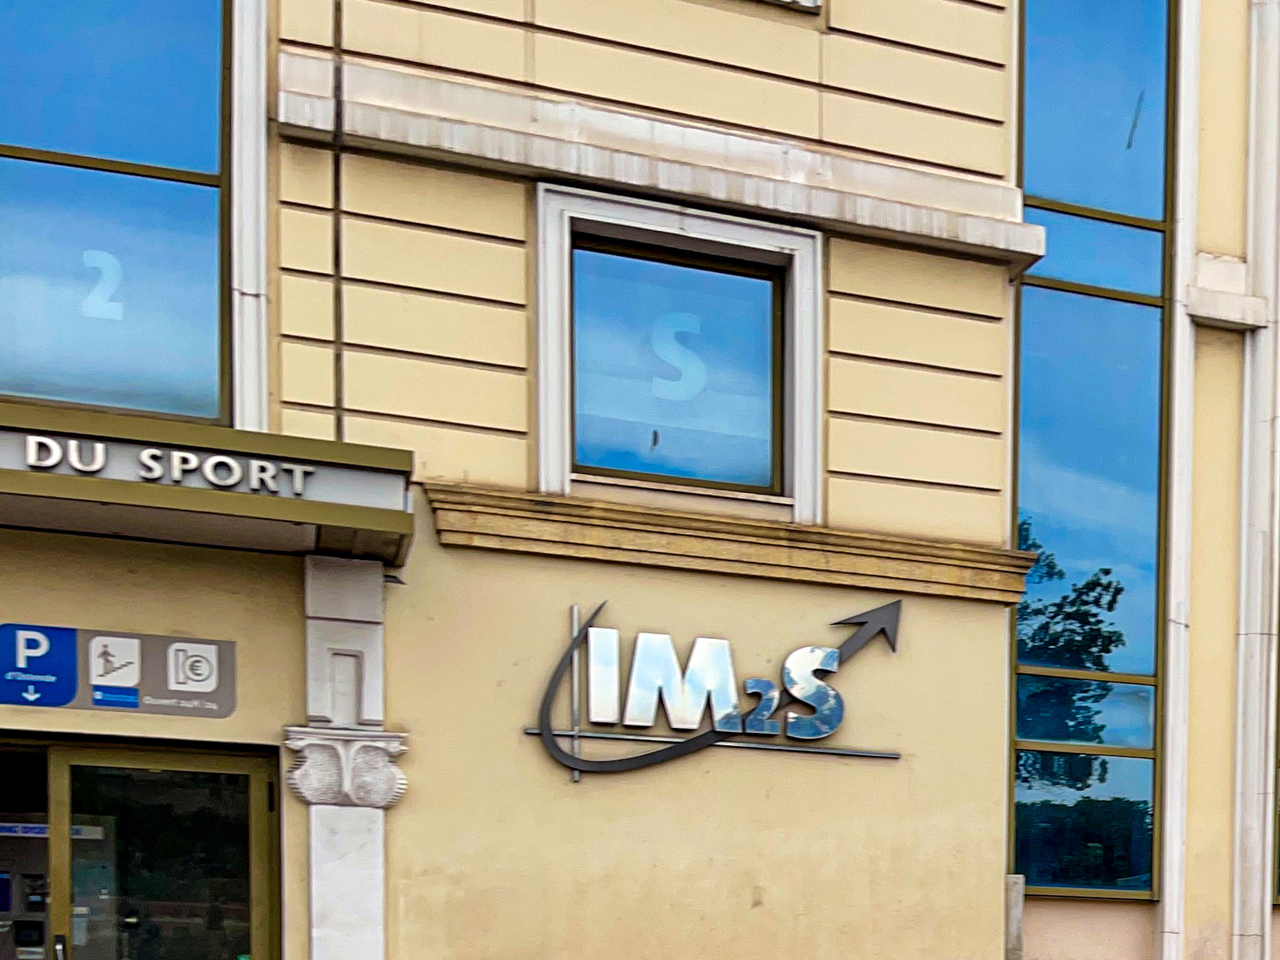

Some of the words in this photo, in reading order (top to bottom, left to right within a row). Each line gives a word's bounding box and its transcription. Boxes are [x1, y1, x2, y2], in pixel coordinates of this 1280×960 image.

[81, 250, 125, 320] 2
[650, 312, 708, 402] S
[25, 435, 106, 473] DU
[139, 447, 316, 496] SPORT
[15, 630, 50, 668] P
